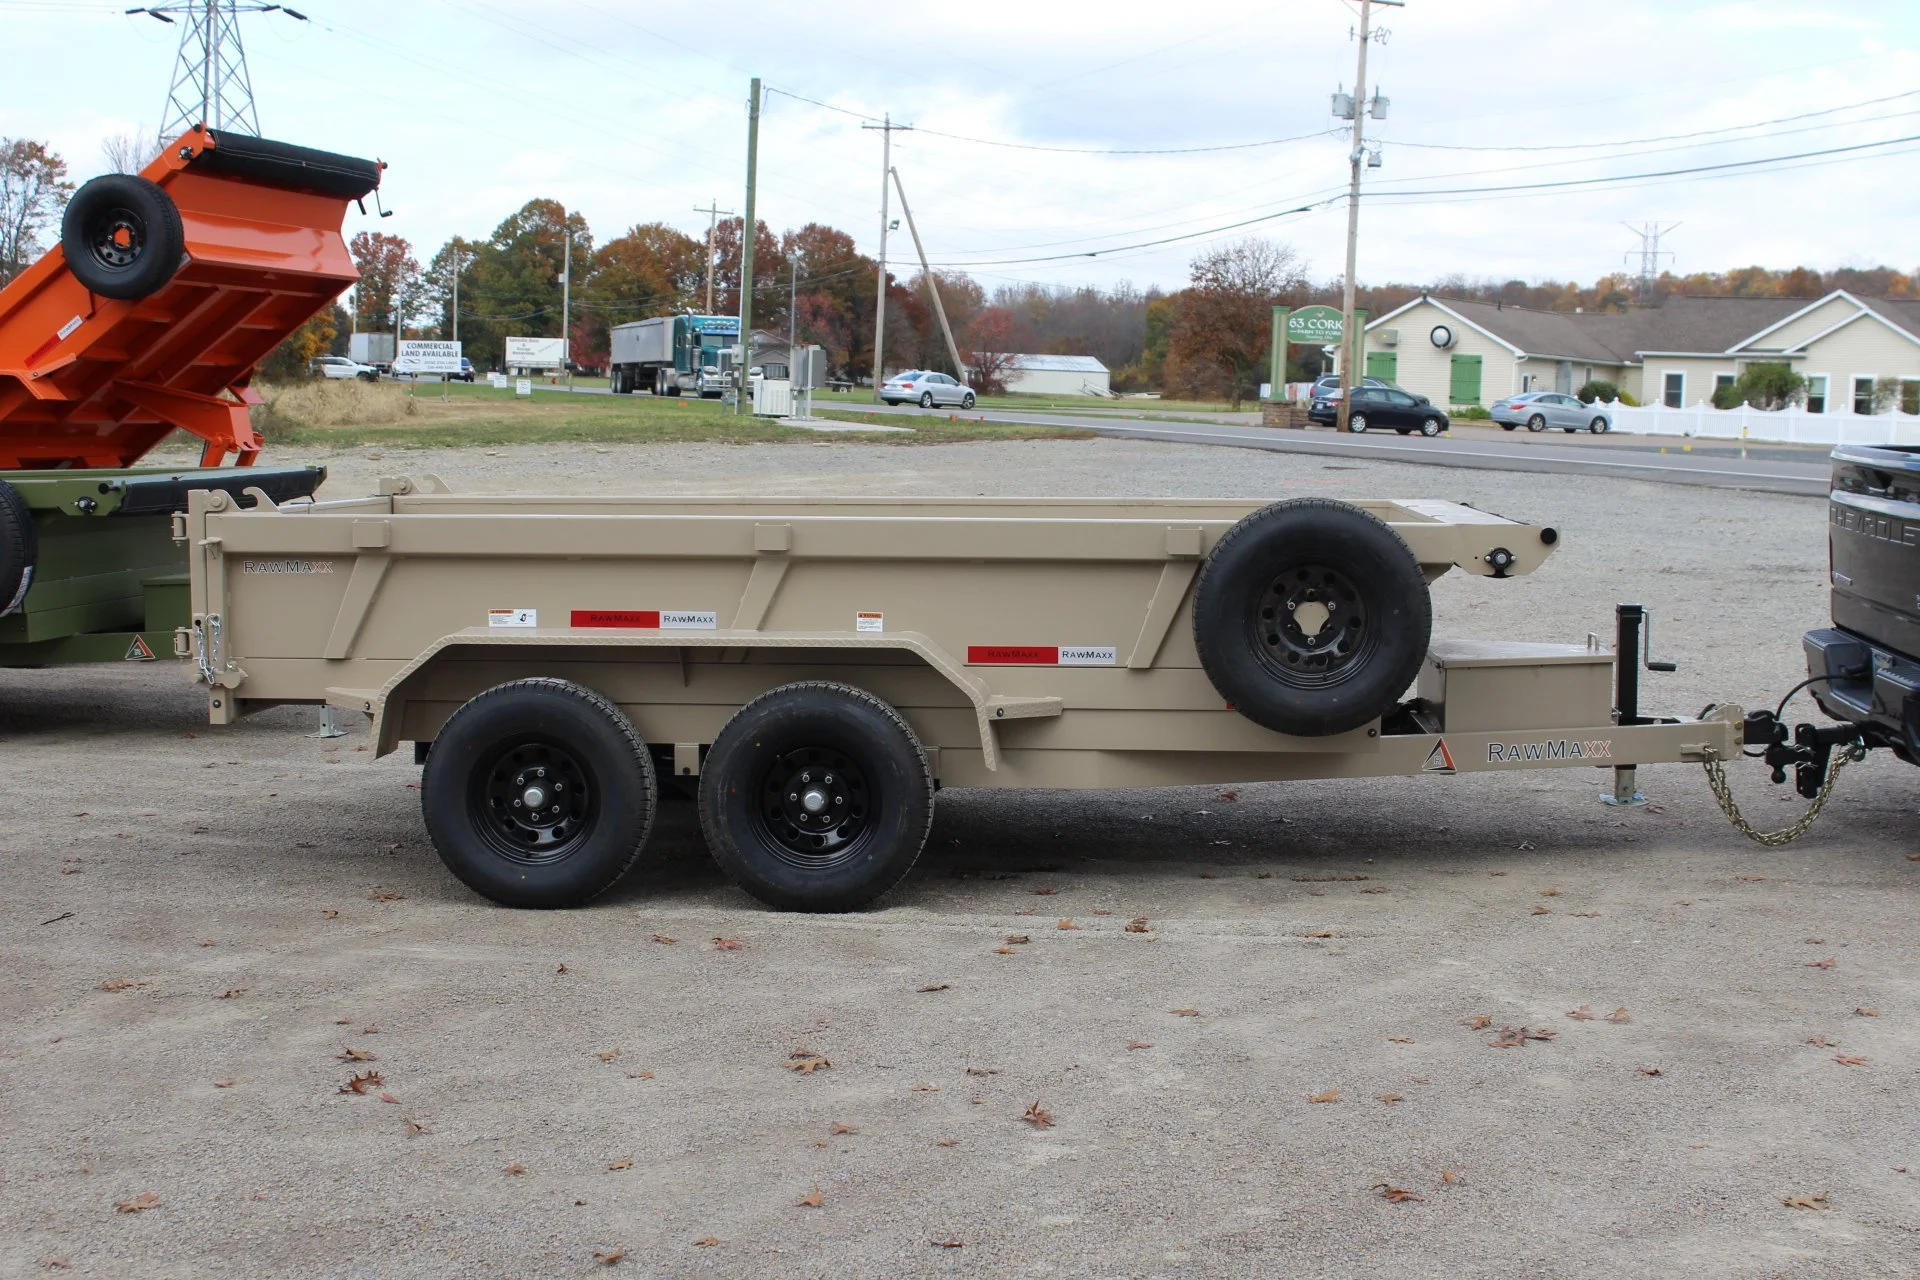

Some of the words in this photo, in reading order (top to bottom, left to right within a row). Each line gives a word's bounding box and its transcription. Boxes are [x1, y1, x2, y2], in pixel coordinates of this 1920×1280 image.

[1289, 318, 1304, 328] 63
[406, 342, 453, 350] COMMERCIAL
[422, 350, 459, 358] AVAILABLE
